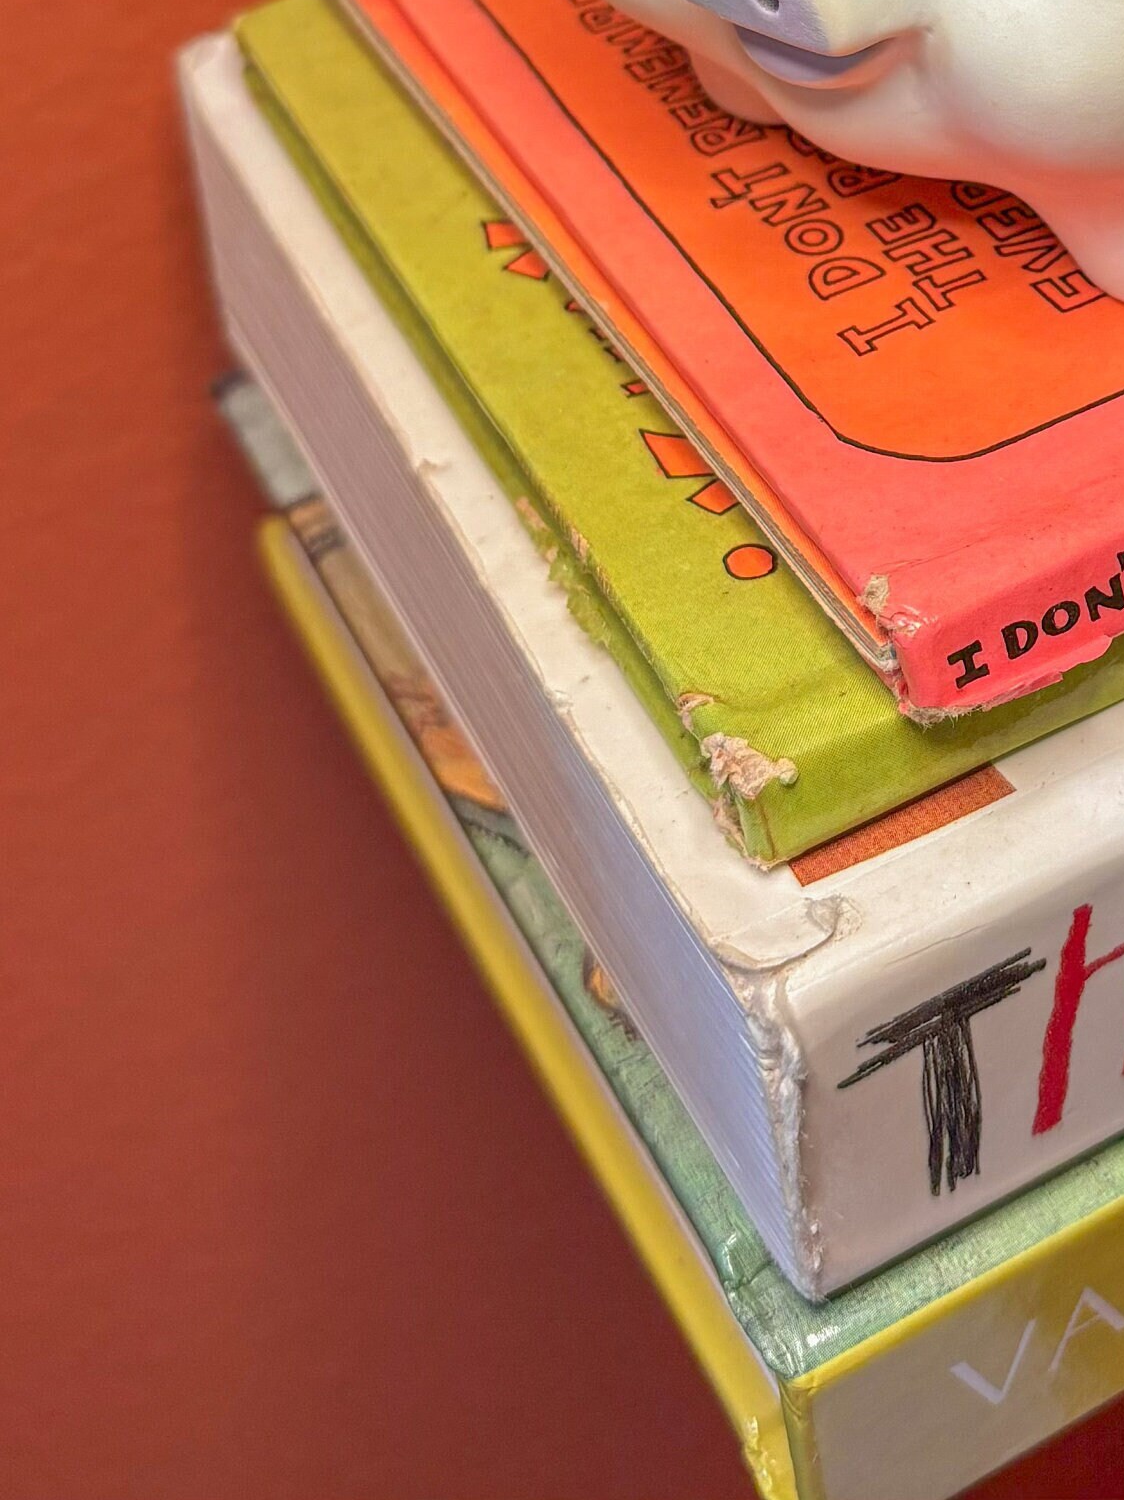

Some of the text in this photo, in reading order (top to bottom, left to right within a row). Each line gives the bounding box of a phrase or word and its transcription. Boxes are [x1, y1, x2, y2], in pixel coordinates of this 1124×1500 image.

[710, 162, 886, 301] DON'T
[866, 201, 988, 313] THE
[836, 296, 936, 357] I
[946, 639, 990, 689] I
